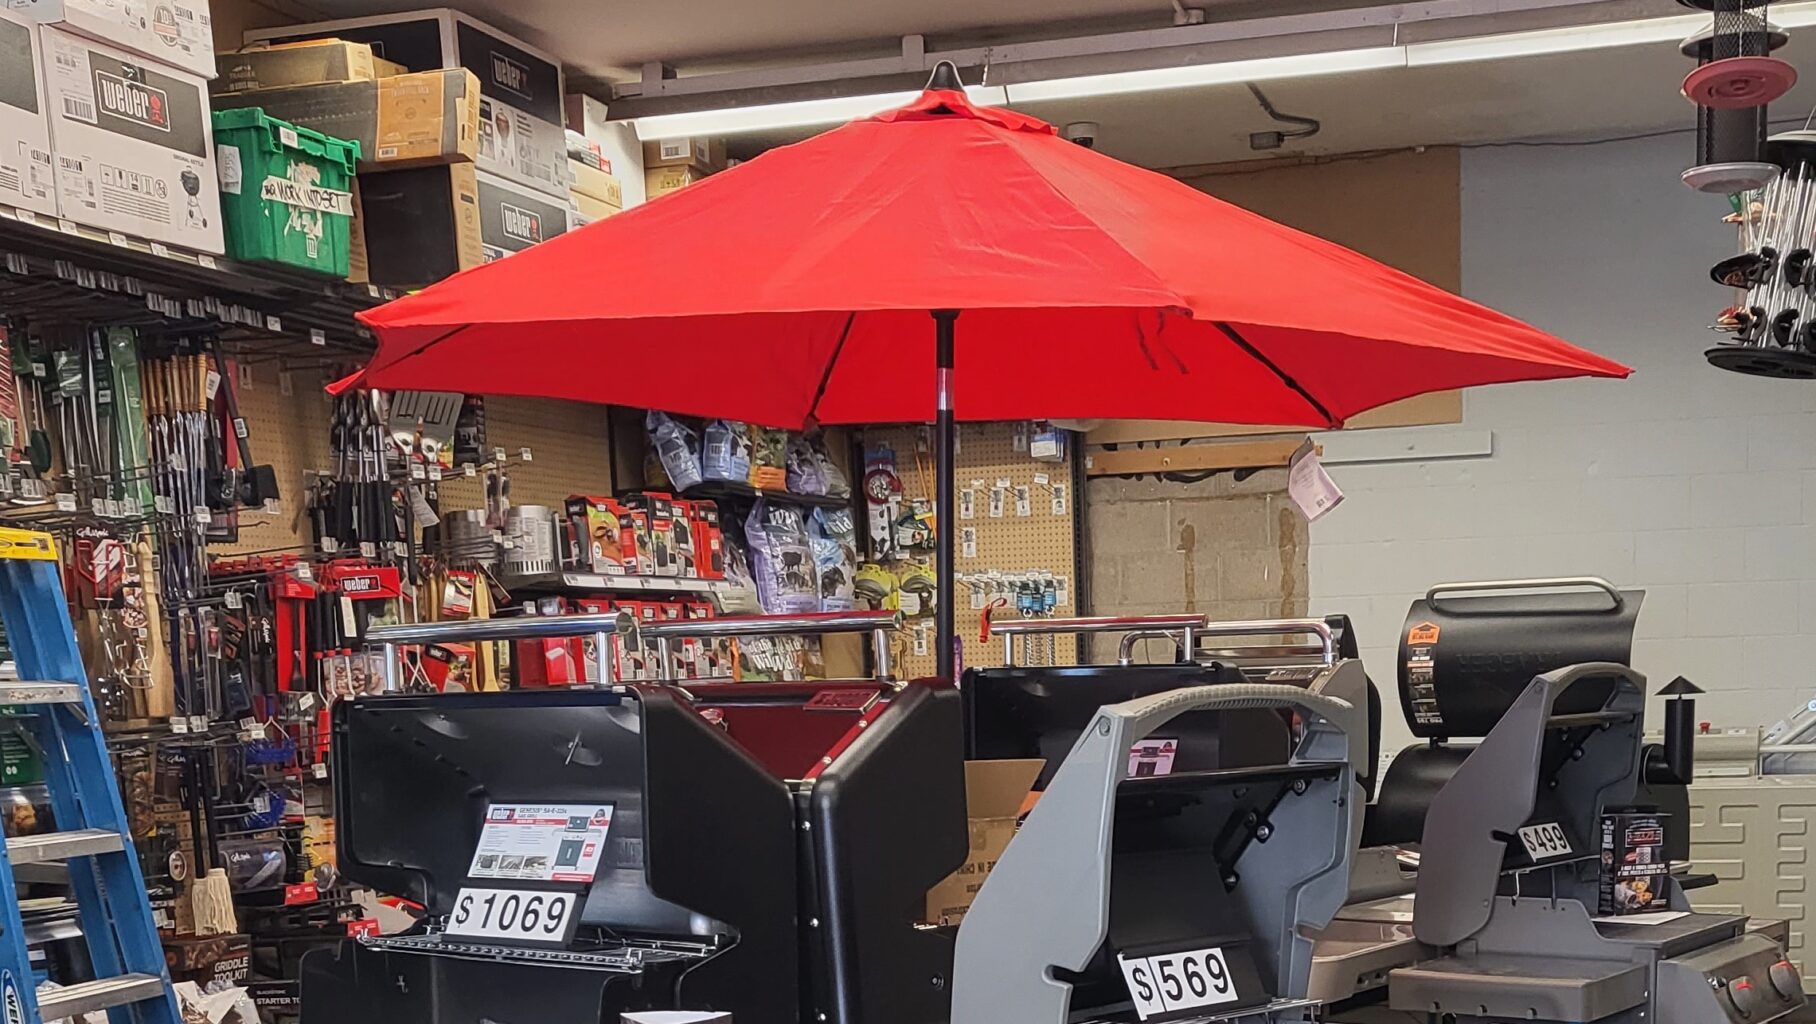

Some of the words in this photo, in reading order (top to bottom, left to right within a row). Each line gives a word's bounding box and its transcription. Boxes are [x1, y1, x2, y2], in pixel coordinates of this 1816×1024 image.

[101, 79, 149, 119] weber
[504, 208, 531, 238] weber
[343, 577, 371, 591] weber
[1523, 825, 1568, 852] $499
[455, 892, 566, 935] $1069
[214, 956, 249, 973] GRIDDLE
[214, 968, 248, 982] TOOLKIT
[1132, 951, 1229, 1006] $569
[256, 997, 292, 1005] STARTER
